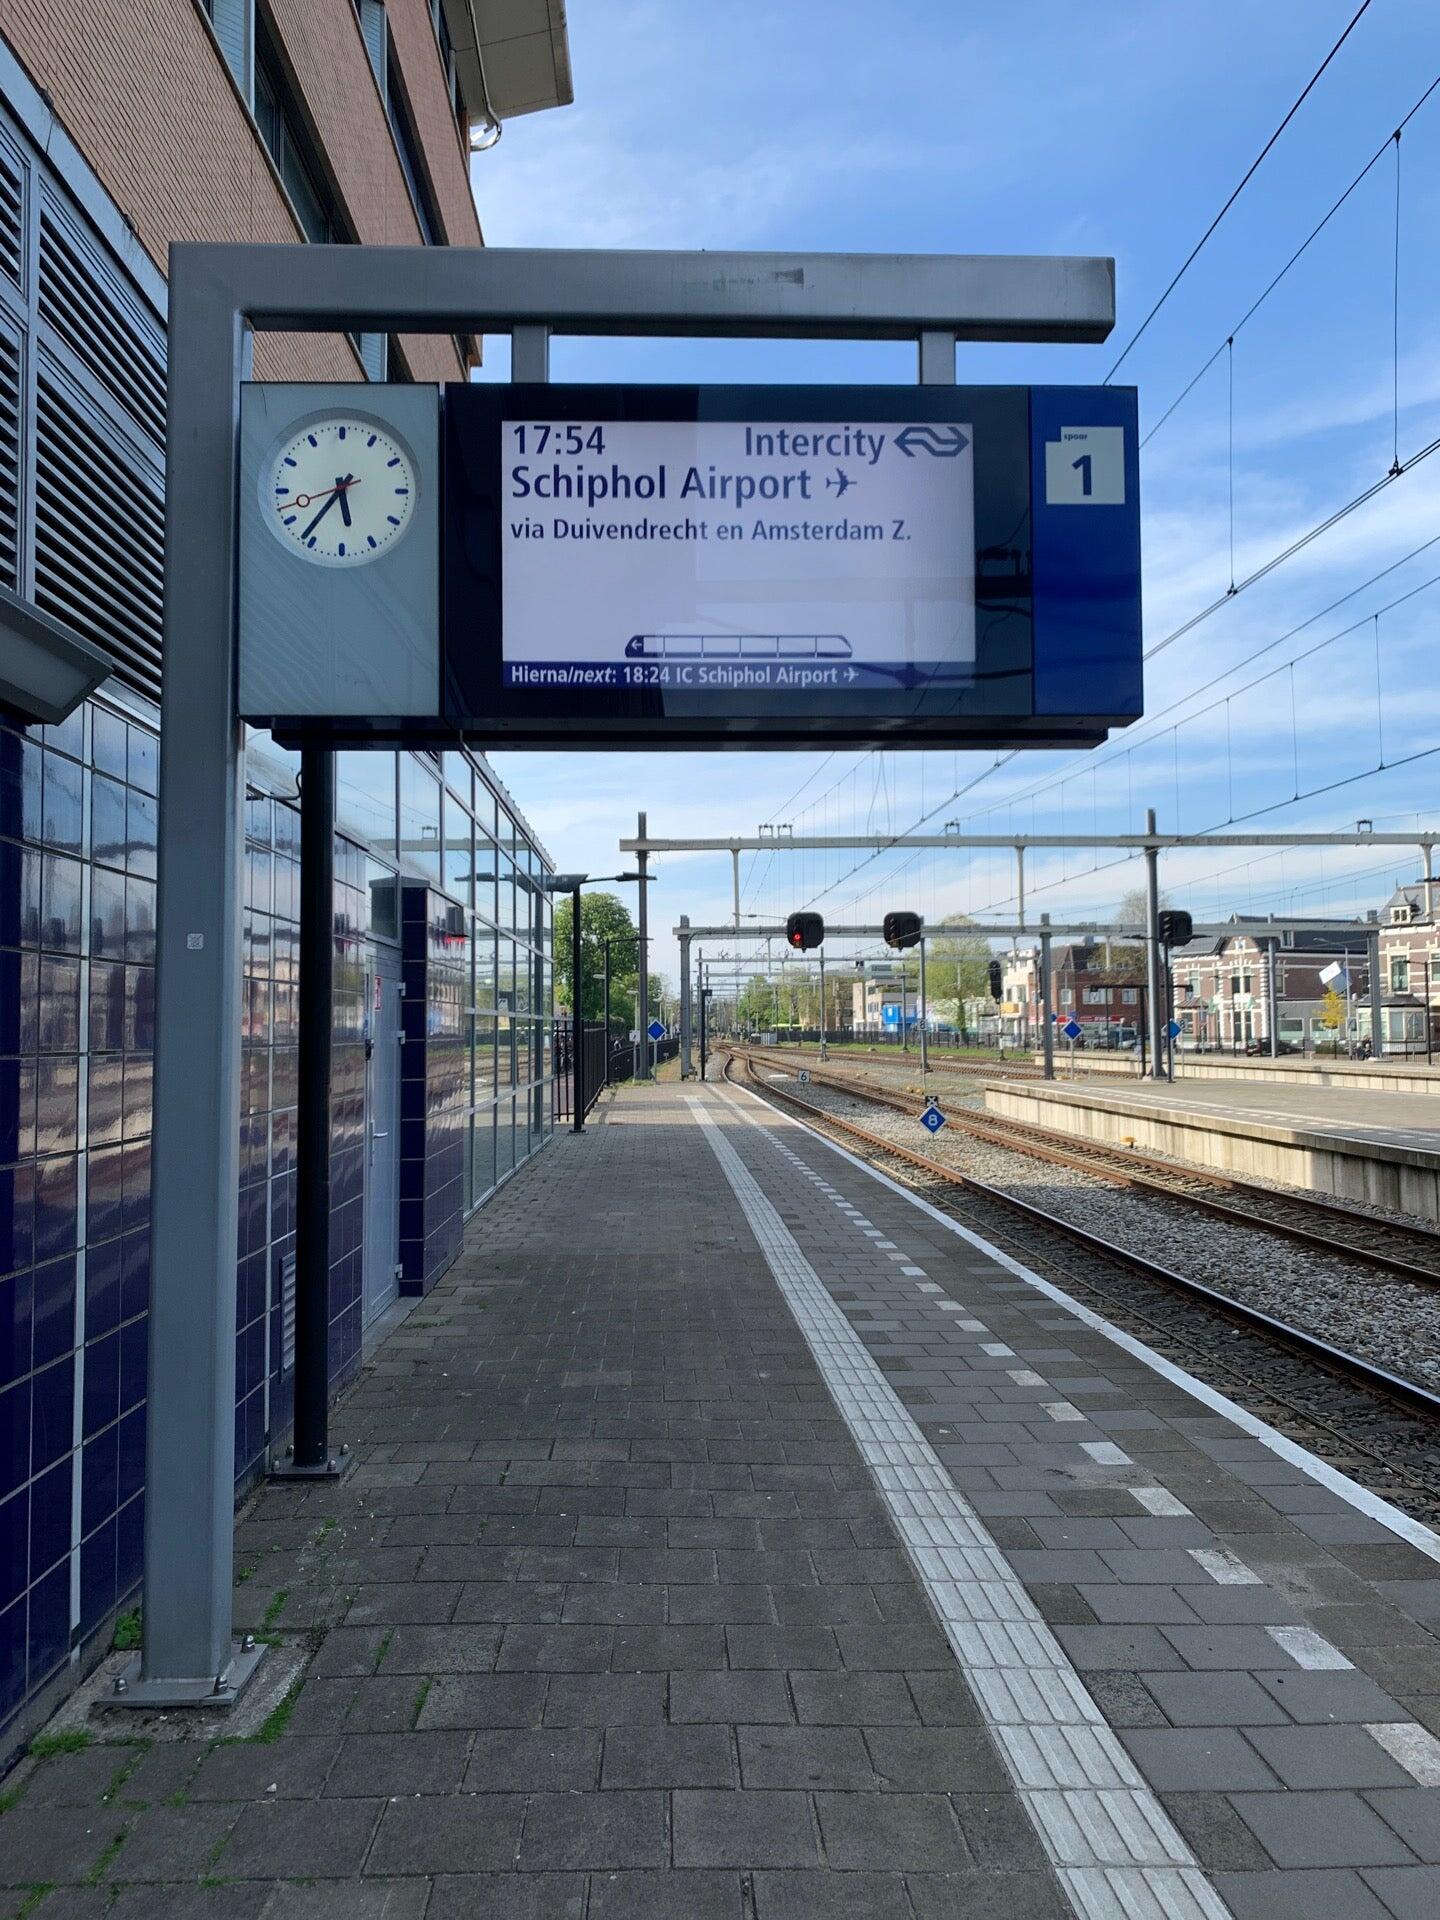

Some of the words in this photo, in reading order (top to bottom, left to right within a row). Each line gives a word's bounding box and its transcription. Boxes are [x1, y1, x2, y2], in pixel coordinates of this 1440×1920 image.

[513, 425, 606, 455] 17:54
[745, 426, 885, 465] Intercity
[1064, 433, 1088, 441] spoor
[511, 465, 667, 508] Schiphol
[680, 467, 812, 508] Airport
[1072, 455, 1092, 495] 1
[510, 518, 545, 540] via
[553, 518, 708, 541] Duivendrecht
[716, 524, 744, 541] en
[751, 519, 884, 541] Amsterdam
[892, 519, 912, 541] Z.
[511, 665, 617, 685] Hierna/next:
[623, 667, 670, 684] 18:24
[676, 667, 693, 684] IC
[698, 665, 771, 687] Schiphol
[777, 667, 838, 688] Airport
[801, 1072, 807, 1081] 6
[929, 1114, 938, 1126] 8
